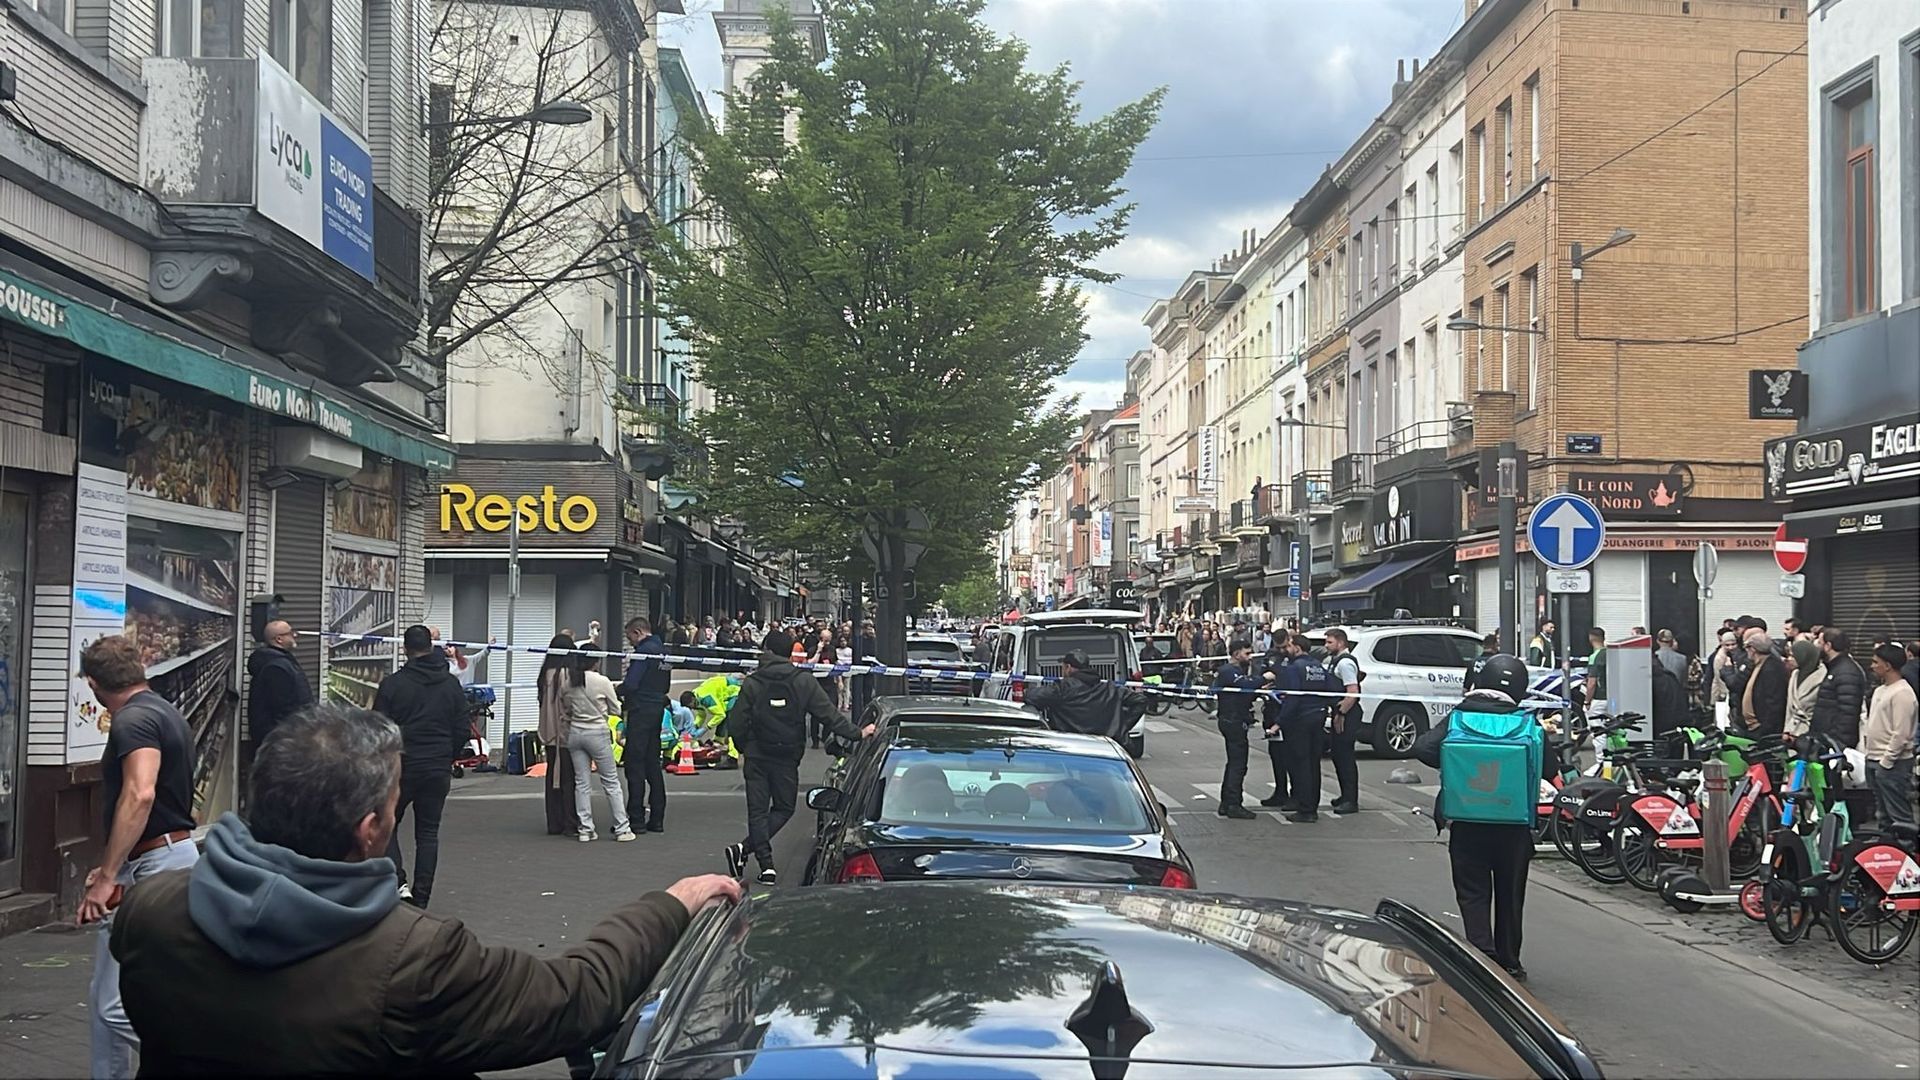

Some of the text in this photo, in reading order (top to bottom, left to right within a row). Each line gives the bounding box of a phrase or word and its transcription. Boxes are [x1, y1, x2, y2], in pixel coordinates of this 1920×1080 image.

[270, 112, 303, 174] Lyca
[329, 155, 366, 199] EURO NORD
[334, 187, 363, 224] TRADING
[249, 375, 281, 411] EURO
[319, 401, 353, 438] TRADING
[1792, 438, 1844, 472] GOLD
[1578, 478, 1633, 491] LE COIN
[1601, 495, 1642, 509] NORD
[440, 484, 598, 532] Resto
[1602, 539, 1664, 547] OULANGERIE
[1736, 539, 1769, 547] SALON
[1438, 673, 1464, 684] Police
